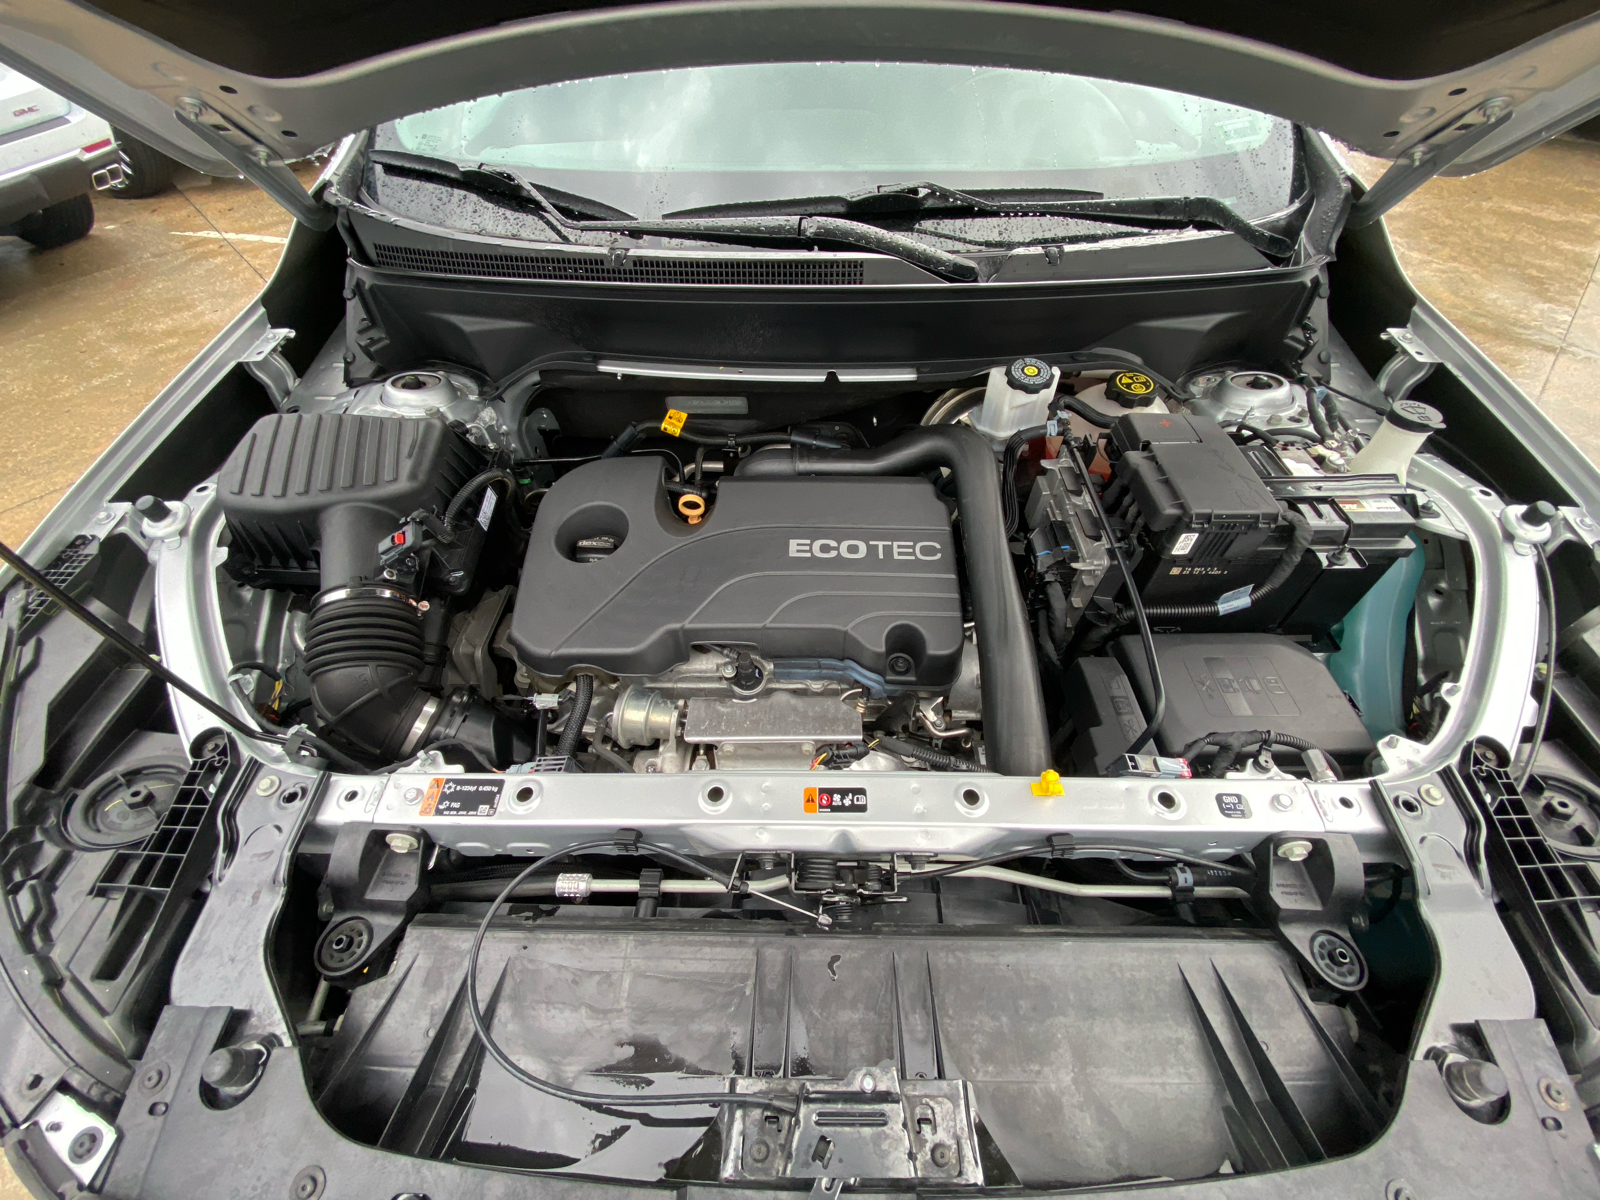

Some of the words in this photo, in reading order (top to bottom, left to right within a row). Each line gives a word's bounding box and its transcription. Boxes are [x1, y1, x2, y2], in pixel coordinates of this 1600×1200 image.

[13, 104, 40, 117] GMC
[788, 539, 942, 561] ECOTEC
[1223, 795, 1239, 803] GND
